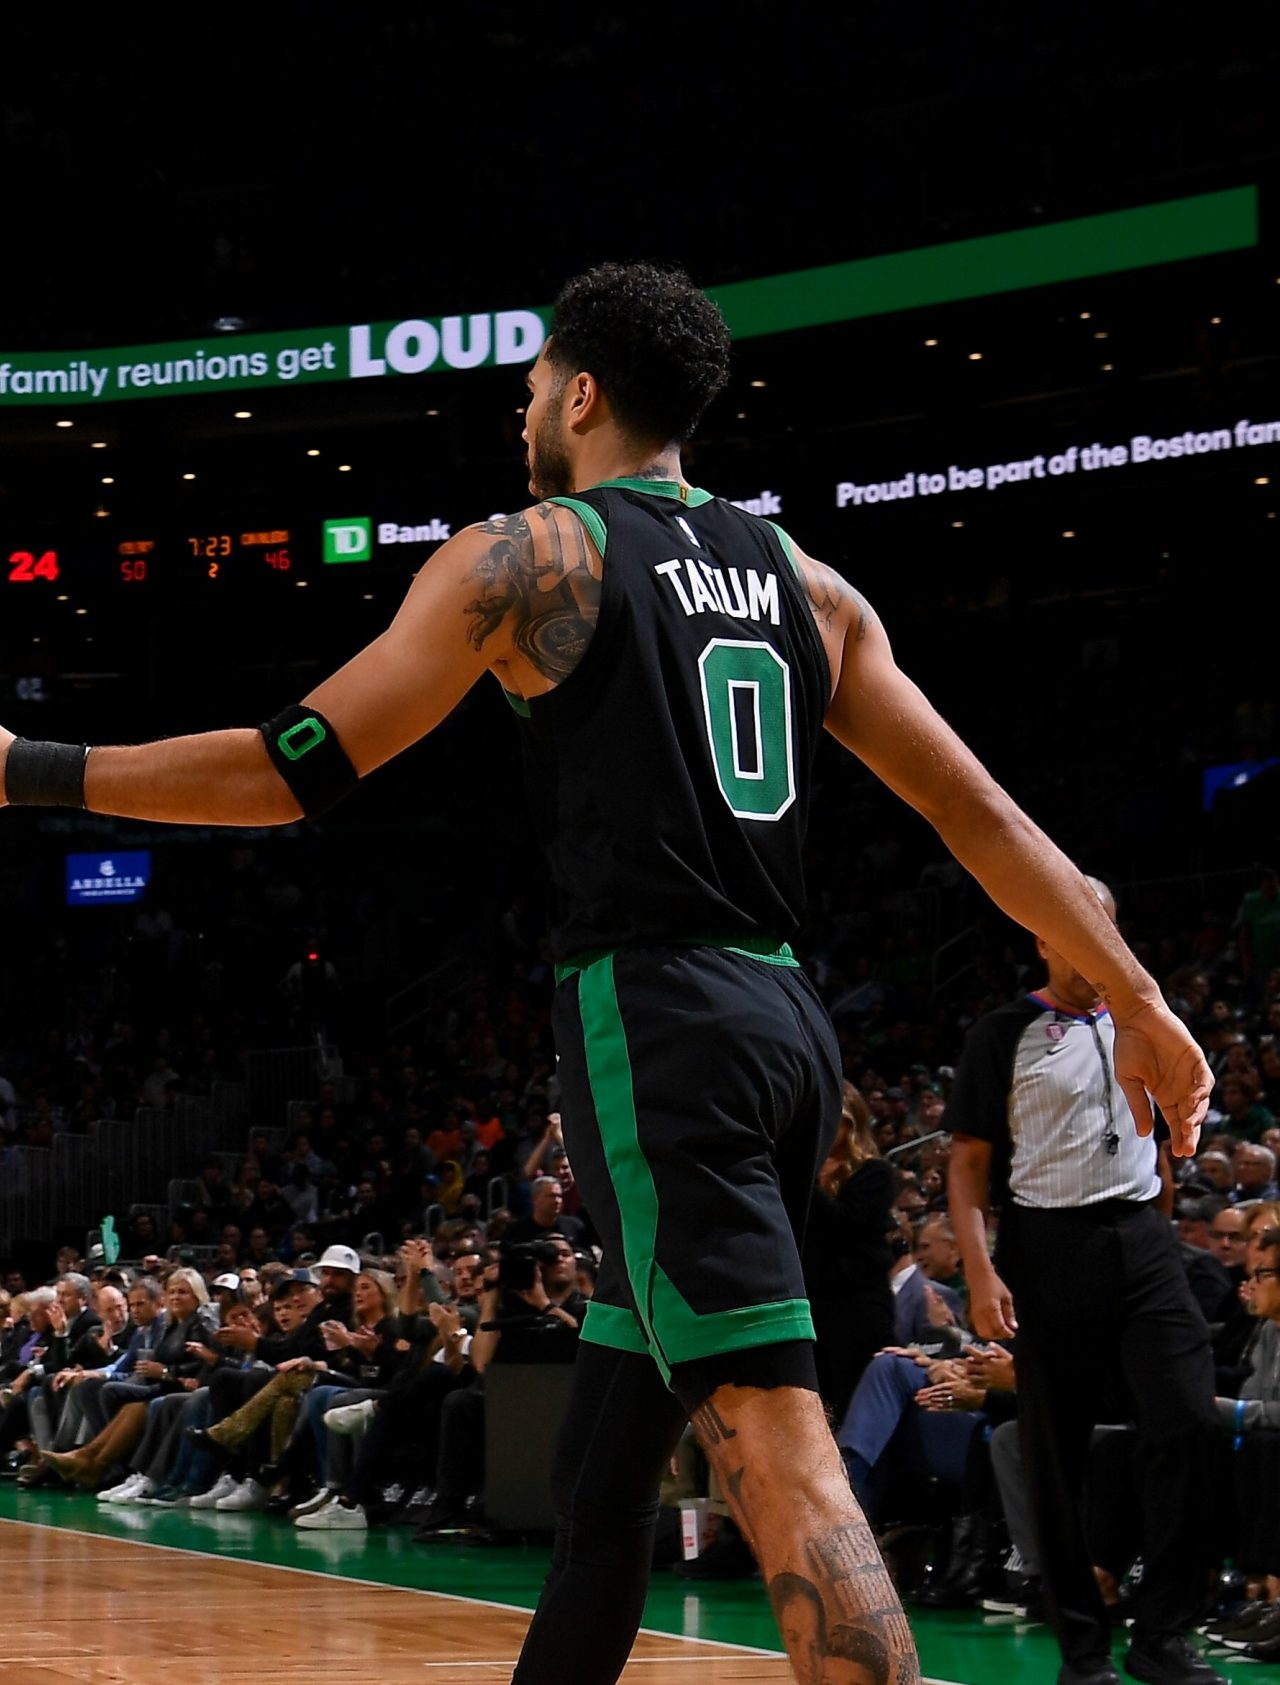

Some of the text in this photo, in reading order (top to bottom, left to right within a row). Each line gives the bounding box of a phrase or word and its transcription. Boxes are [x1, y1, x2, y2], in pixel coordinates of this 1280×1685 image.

[118, 351, 267, 387] reunions
[277, 343, 335, 379] get
[350, 310, 545, 378] LOUD
[837, 473, 914, 507] Proud
[917, 474, 946, 495] to
[949, 466, 984, 490] be
[987, 456, 1045, 489] part
[1048, 447, 1077, 475] of
[1080, 443, 1128, 470] the
[1131, 430, 1231, 462] Boston
[188, 535, 231, 556] 7:23
[328, 519, 451, 553] TD Bank
[9, 551, 59, 581] 24
[120, 560, 147, 581] 50
[208, 562, 219, 578] 2
[264, 550, 291, 571] 46
[655, 559, 780, 625] TATUM
[277, 717, 326, 760] 0
[698, 637, 796, 821] 0
